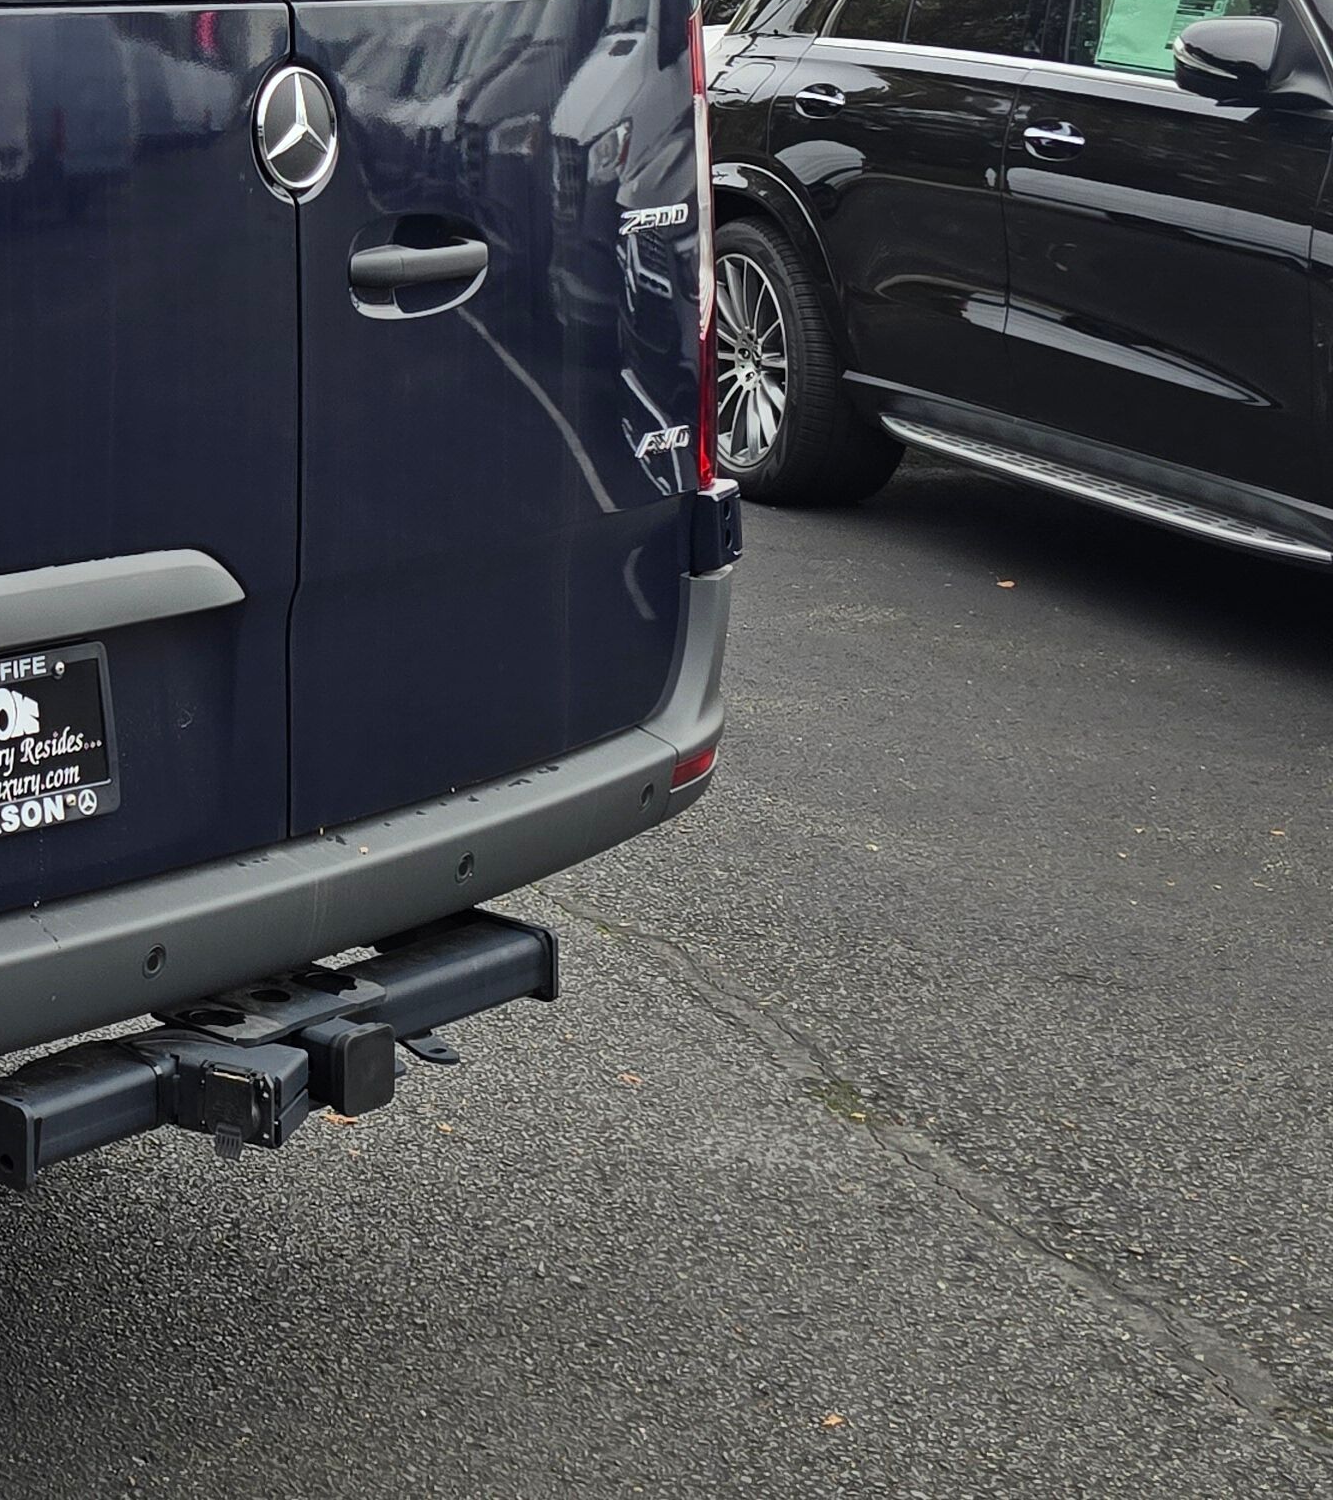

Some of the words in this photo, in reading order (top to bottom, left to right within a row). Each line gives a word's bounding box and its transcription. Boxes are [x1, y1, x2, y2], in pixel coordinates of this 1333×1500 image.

[619, 203, 689, 235] 2500
[635, 425, 690, 458] AWD
[0, 655, 47, 682] FIFE
[20, 726, 102, 764] Resides...
